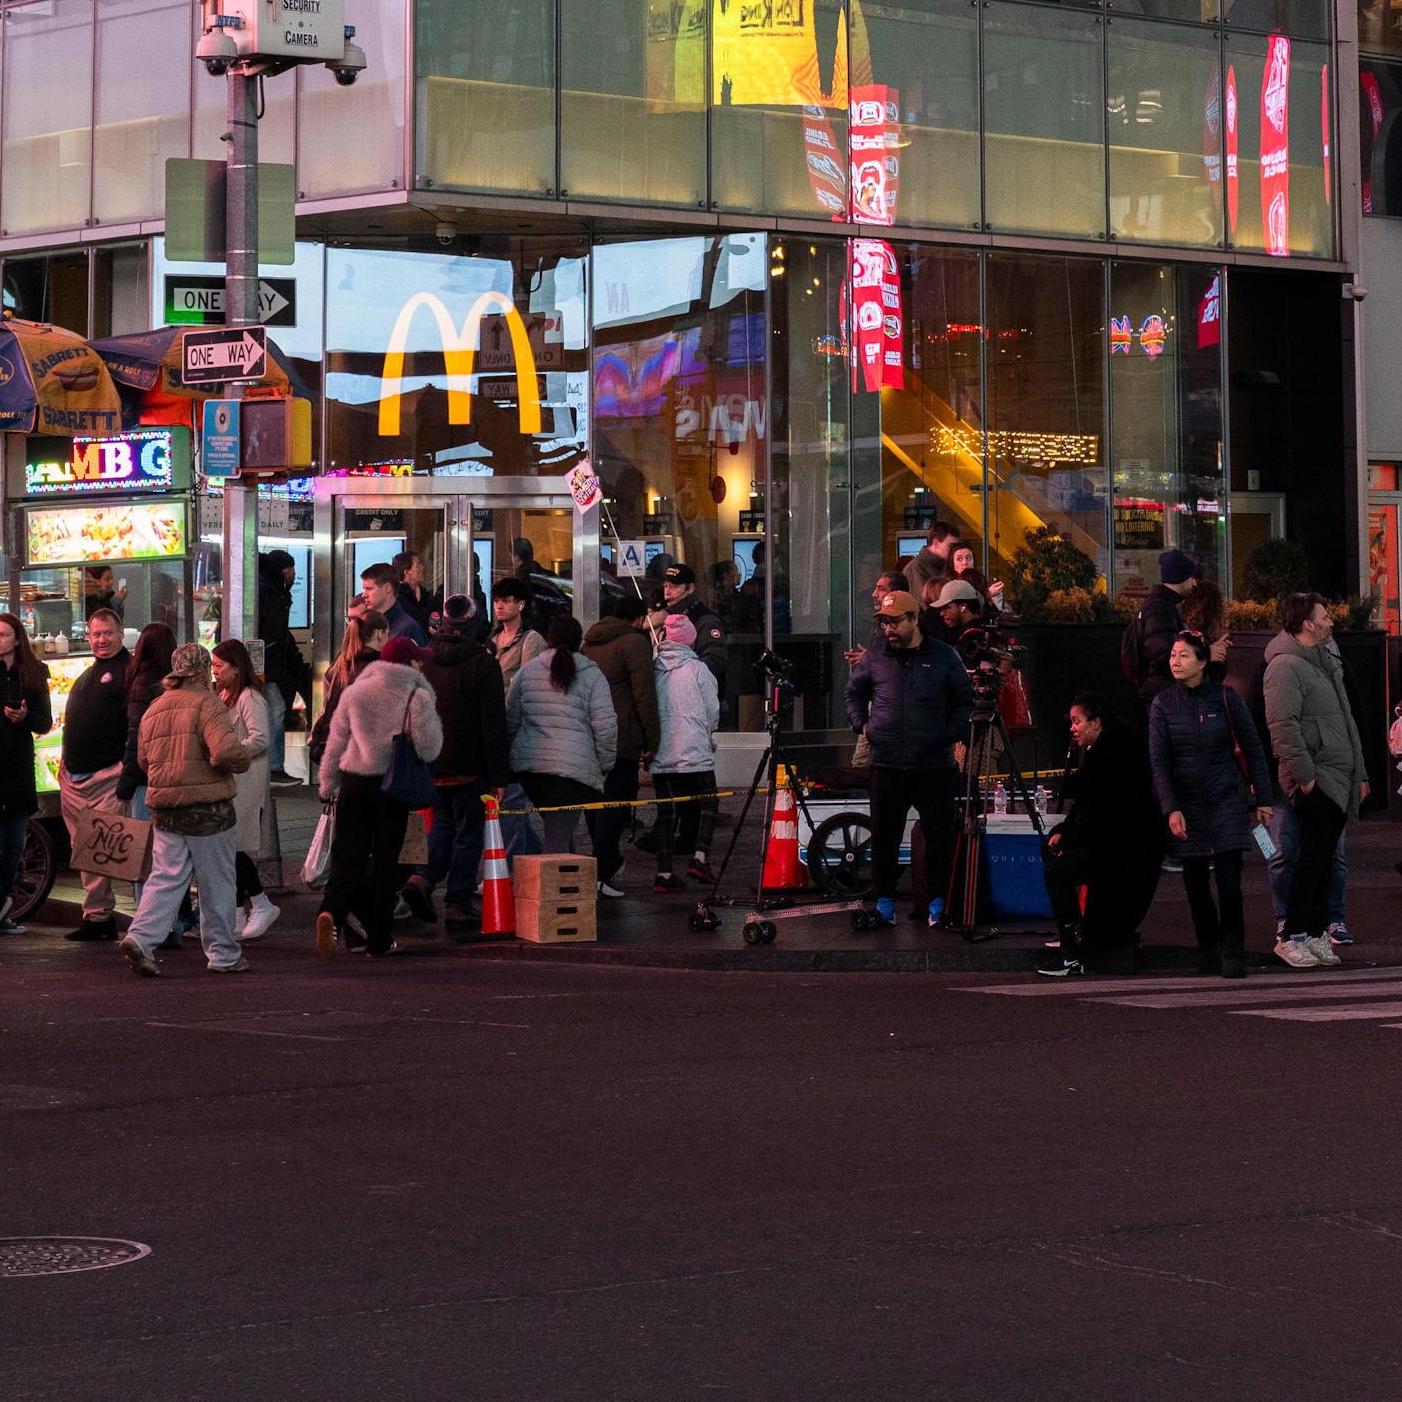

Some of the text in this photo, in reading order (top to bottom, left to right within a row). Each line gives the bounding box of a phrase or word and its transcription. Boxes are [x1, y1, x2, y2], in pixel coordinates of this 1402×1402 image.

[217, 15, 241, 28] NYPD
[285, 31, 319, 46] CAMERA
[184, 291, 221, 310] ONE
[32, 348, 89, 379] SABRETT
[190, 342, 254, 367] ONE WAY
[44, 408, 117, 432] SABRETT
[261, 520, 284, 529] DAILY
[622, 544, 640, 566] A
